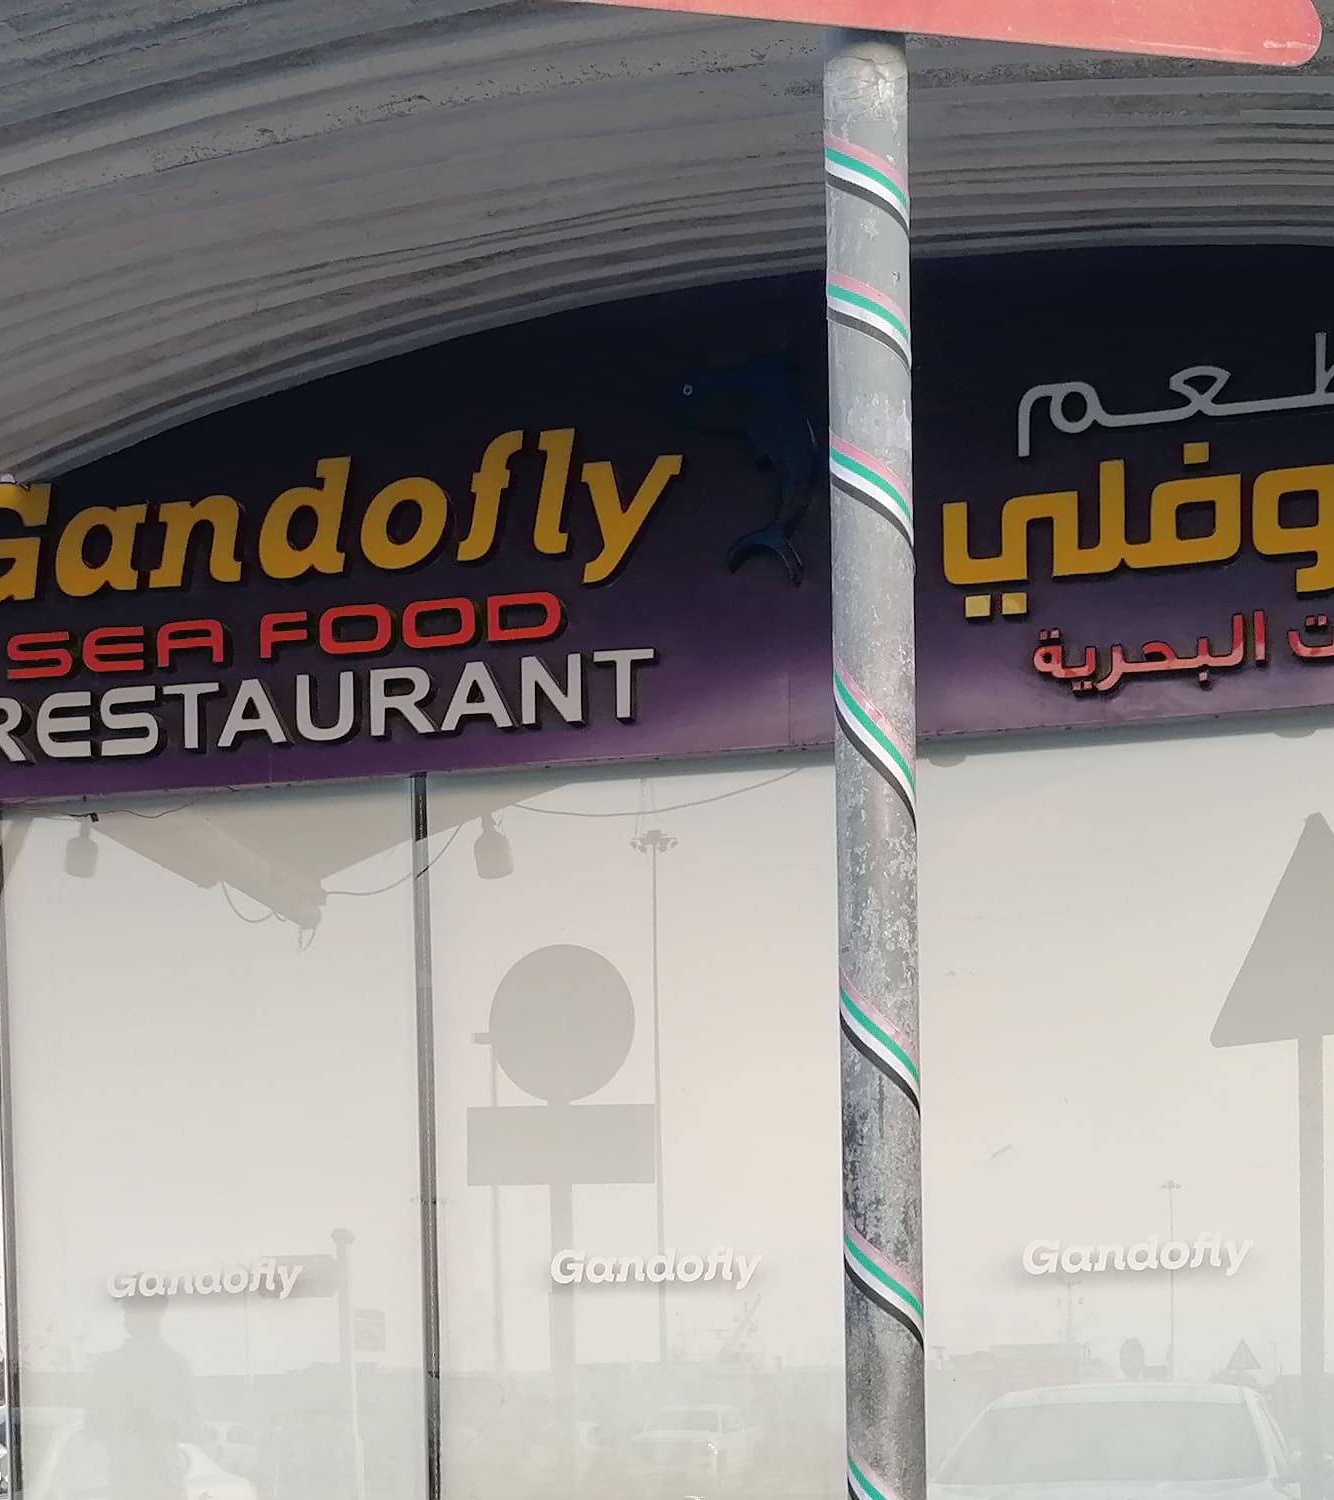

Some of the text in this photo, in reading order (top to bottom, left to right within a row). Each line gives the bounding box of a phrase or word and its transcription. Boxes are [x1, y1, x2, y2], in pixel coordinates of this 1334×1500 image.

[6, 592, 562, 680] SEA FOOD
[1033, 611, 1267, 691] البحرية
[550, 1246, 763, 1290] Gandofly
[1021, 1230, 1253, 1276] Gandofly
[106, 1257, 303, 1299] Gandofly
